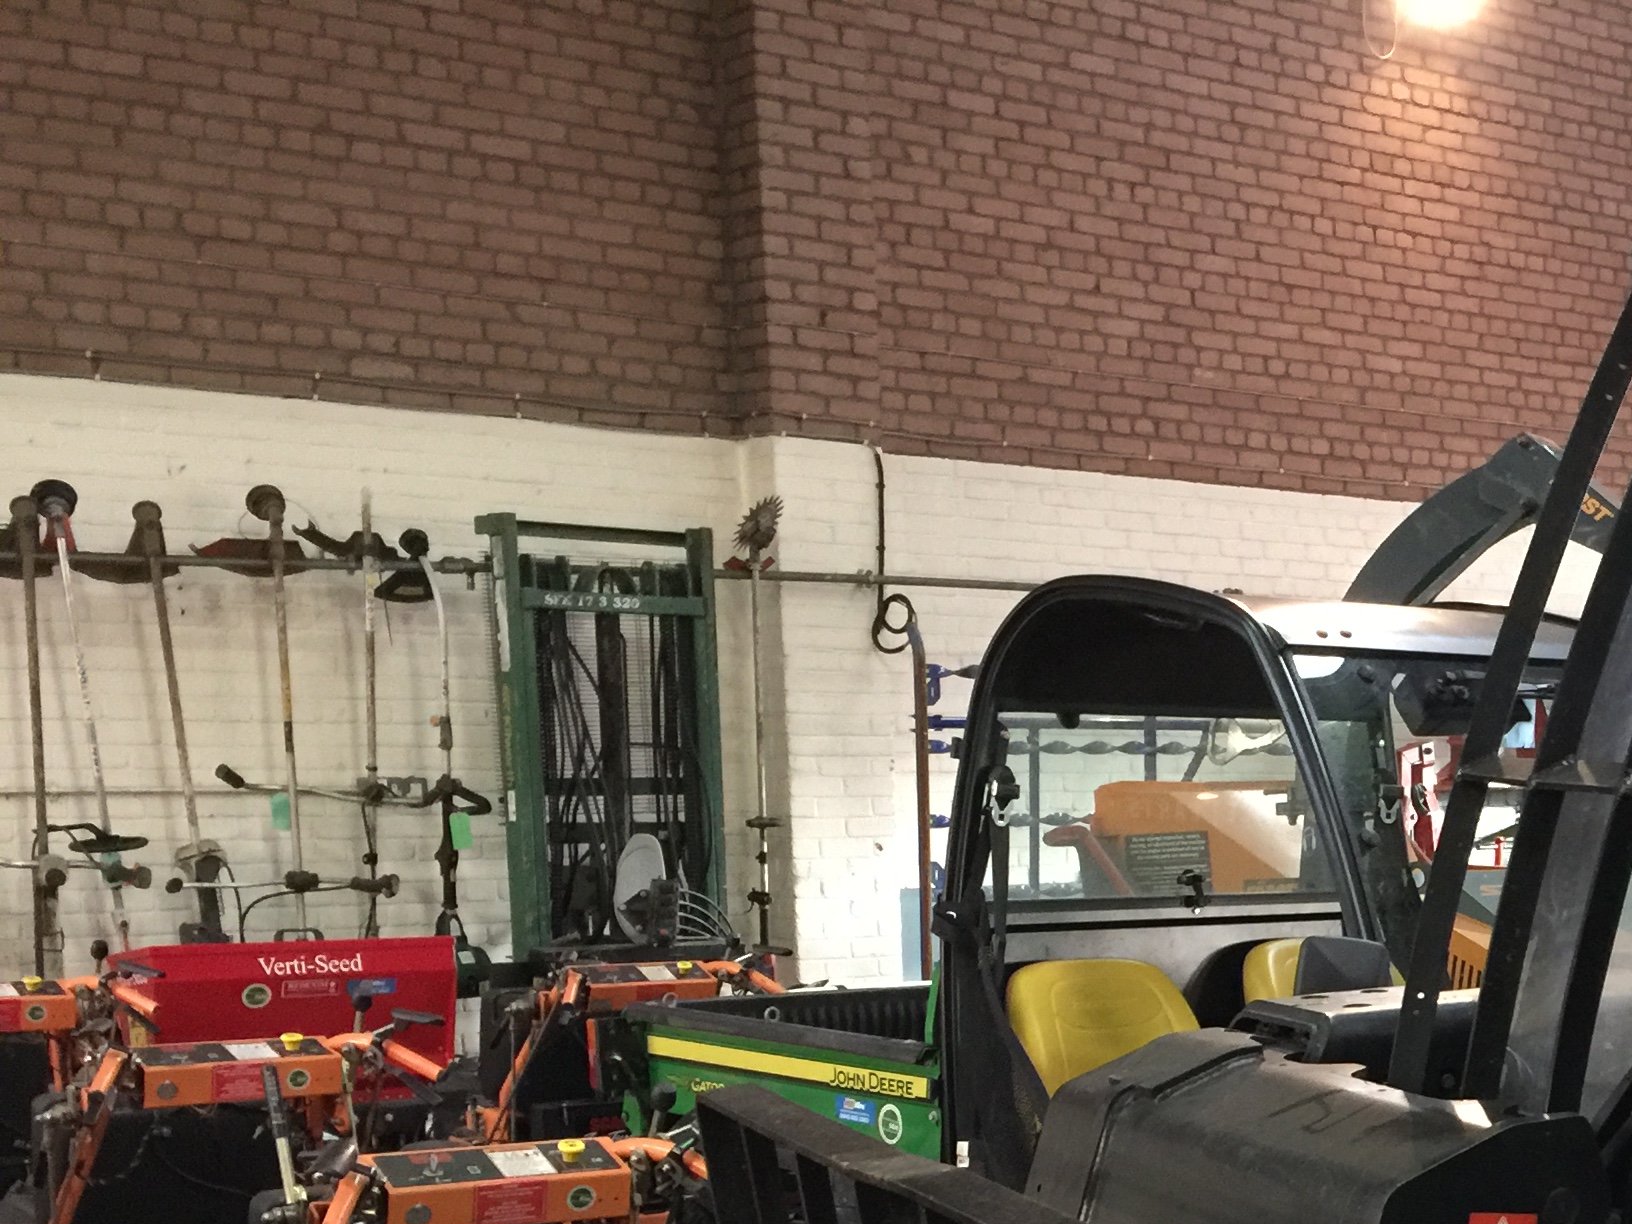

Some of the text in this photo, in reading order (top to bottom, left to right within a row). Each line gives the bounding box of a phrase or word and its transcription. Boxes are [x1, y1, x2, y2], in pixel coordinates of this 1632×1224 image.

[258, 953, 363, 976] Verti-Seed
[829, 1067, 914, 1096] JOHN DEERE
